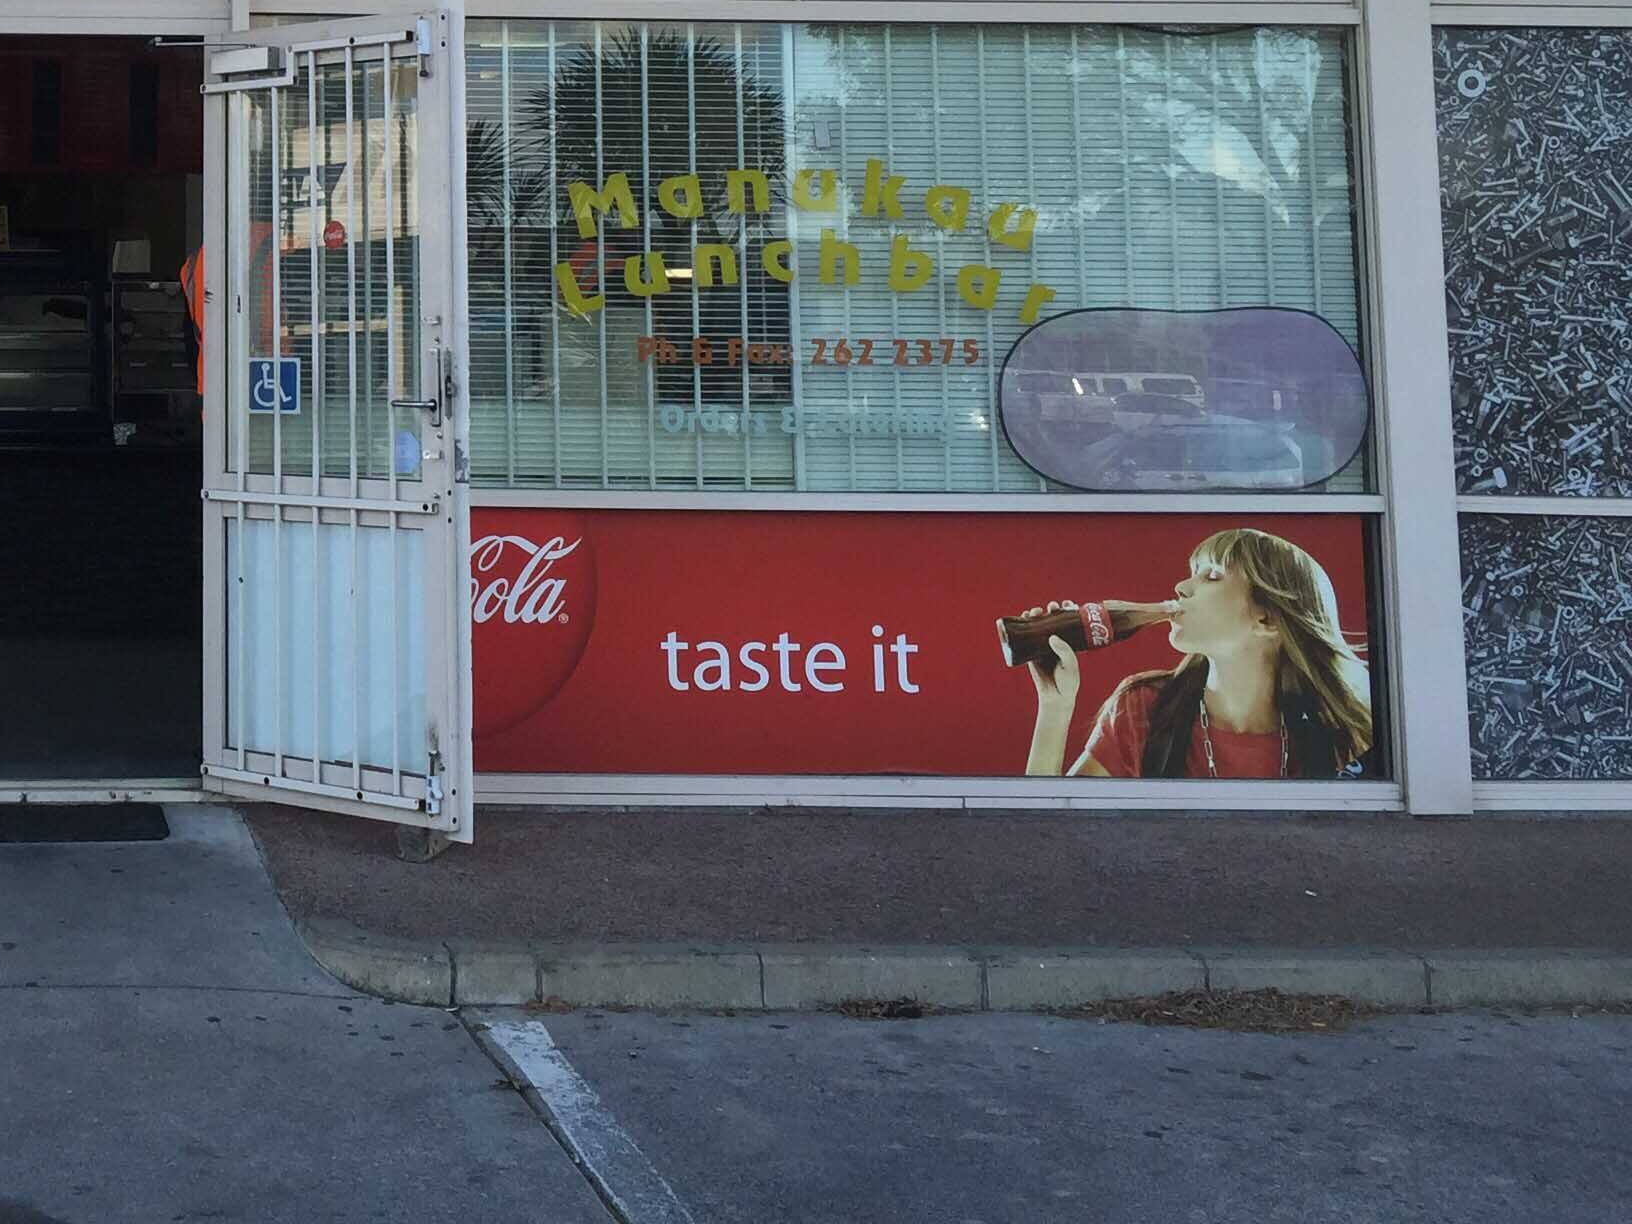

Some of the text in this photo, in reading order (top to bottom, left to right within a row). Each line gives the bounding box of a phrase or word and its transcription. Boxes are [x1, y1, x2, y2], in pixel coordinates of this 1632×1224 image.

[568, 159, 1039, 251] Manukau
[555, 228, 1057, 324] Lunchbar
[636, 337, 677, 365] Ph
[811, 338, 874, 366] 262
[892, 338, 979, 366] 2375
[660, 624, 920, 693] taste it
